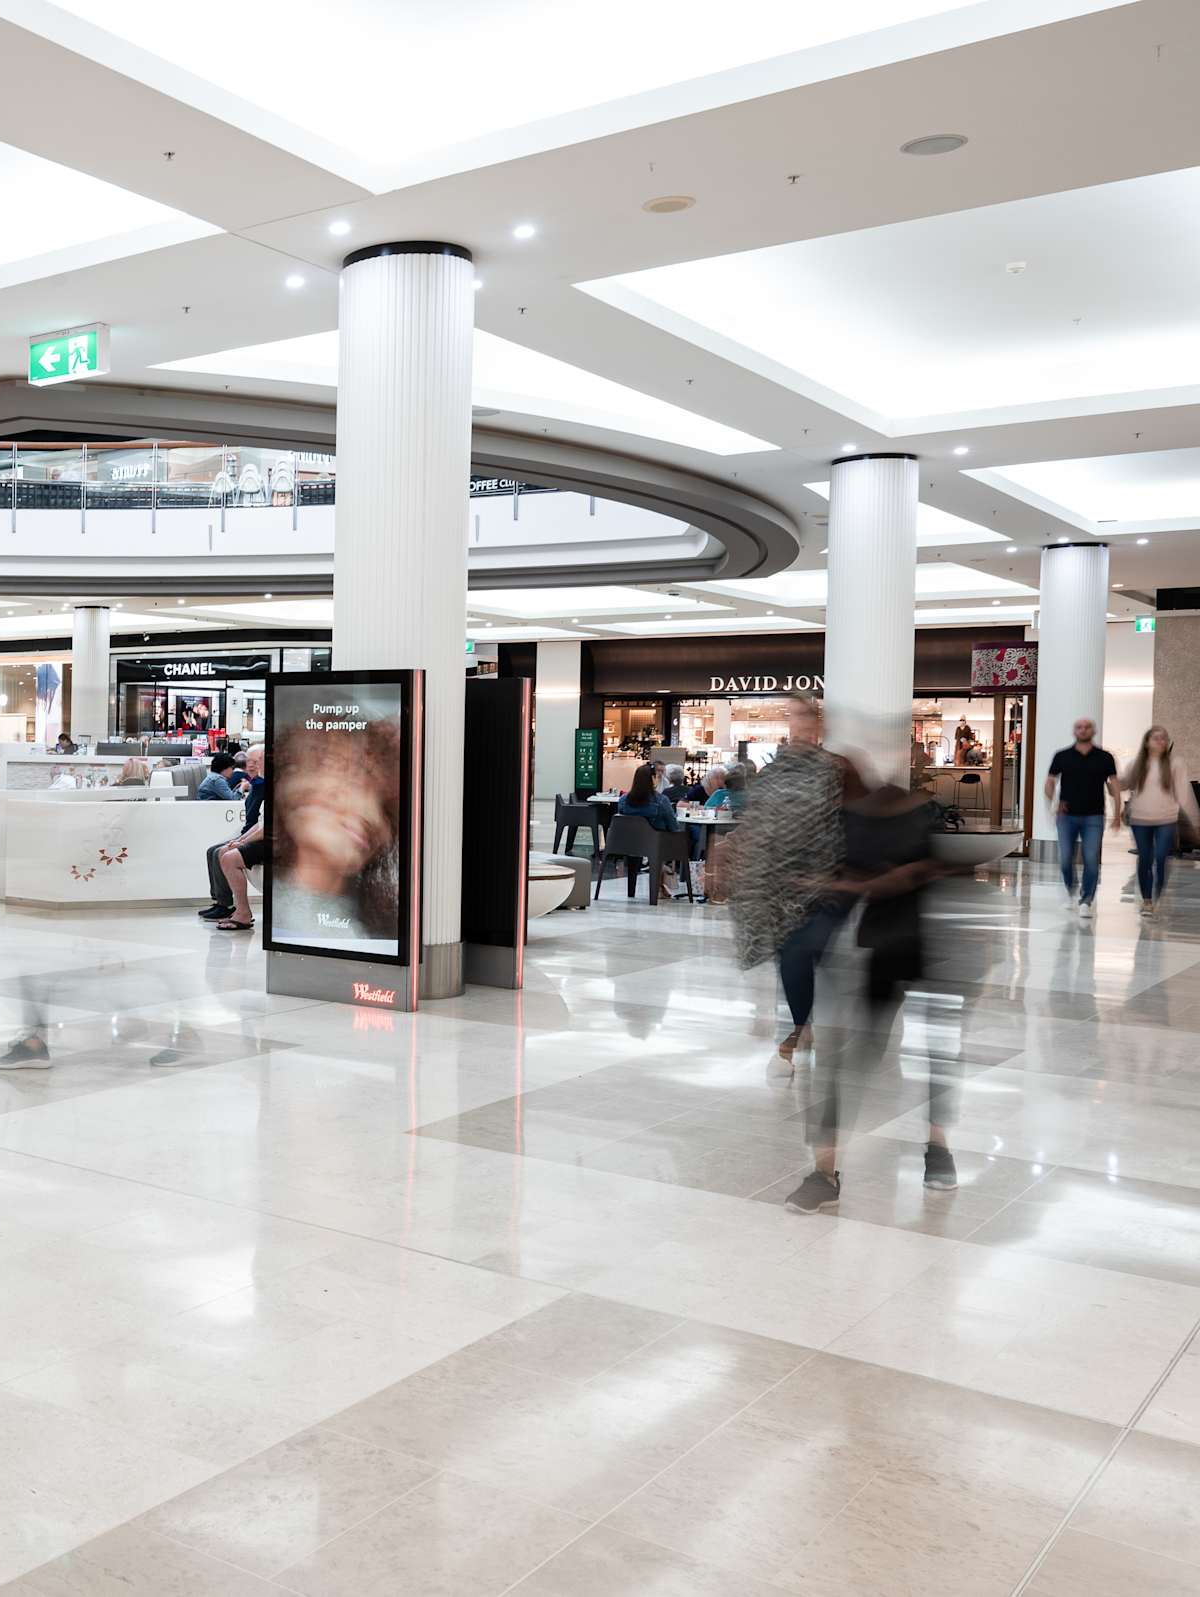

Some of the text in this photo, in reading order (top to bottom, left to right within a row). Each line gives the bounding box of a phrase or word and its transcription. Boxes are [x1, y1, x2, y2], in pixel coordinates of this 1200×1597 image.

[470, 479, 515, 491] OFFEE CLU
[164, 662, 216, 676] CHANEL
[710, 675, 824, 691] DAVID JON
[313, 704, 360, 716] Pump up
[305, 719, 367, 732] the pamper
[317, 912, 351, 929] Westfield
[352, 982, 395, 1004] Westfield
